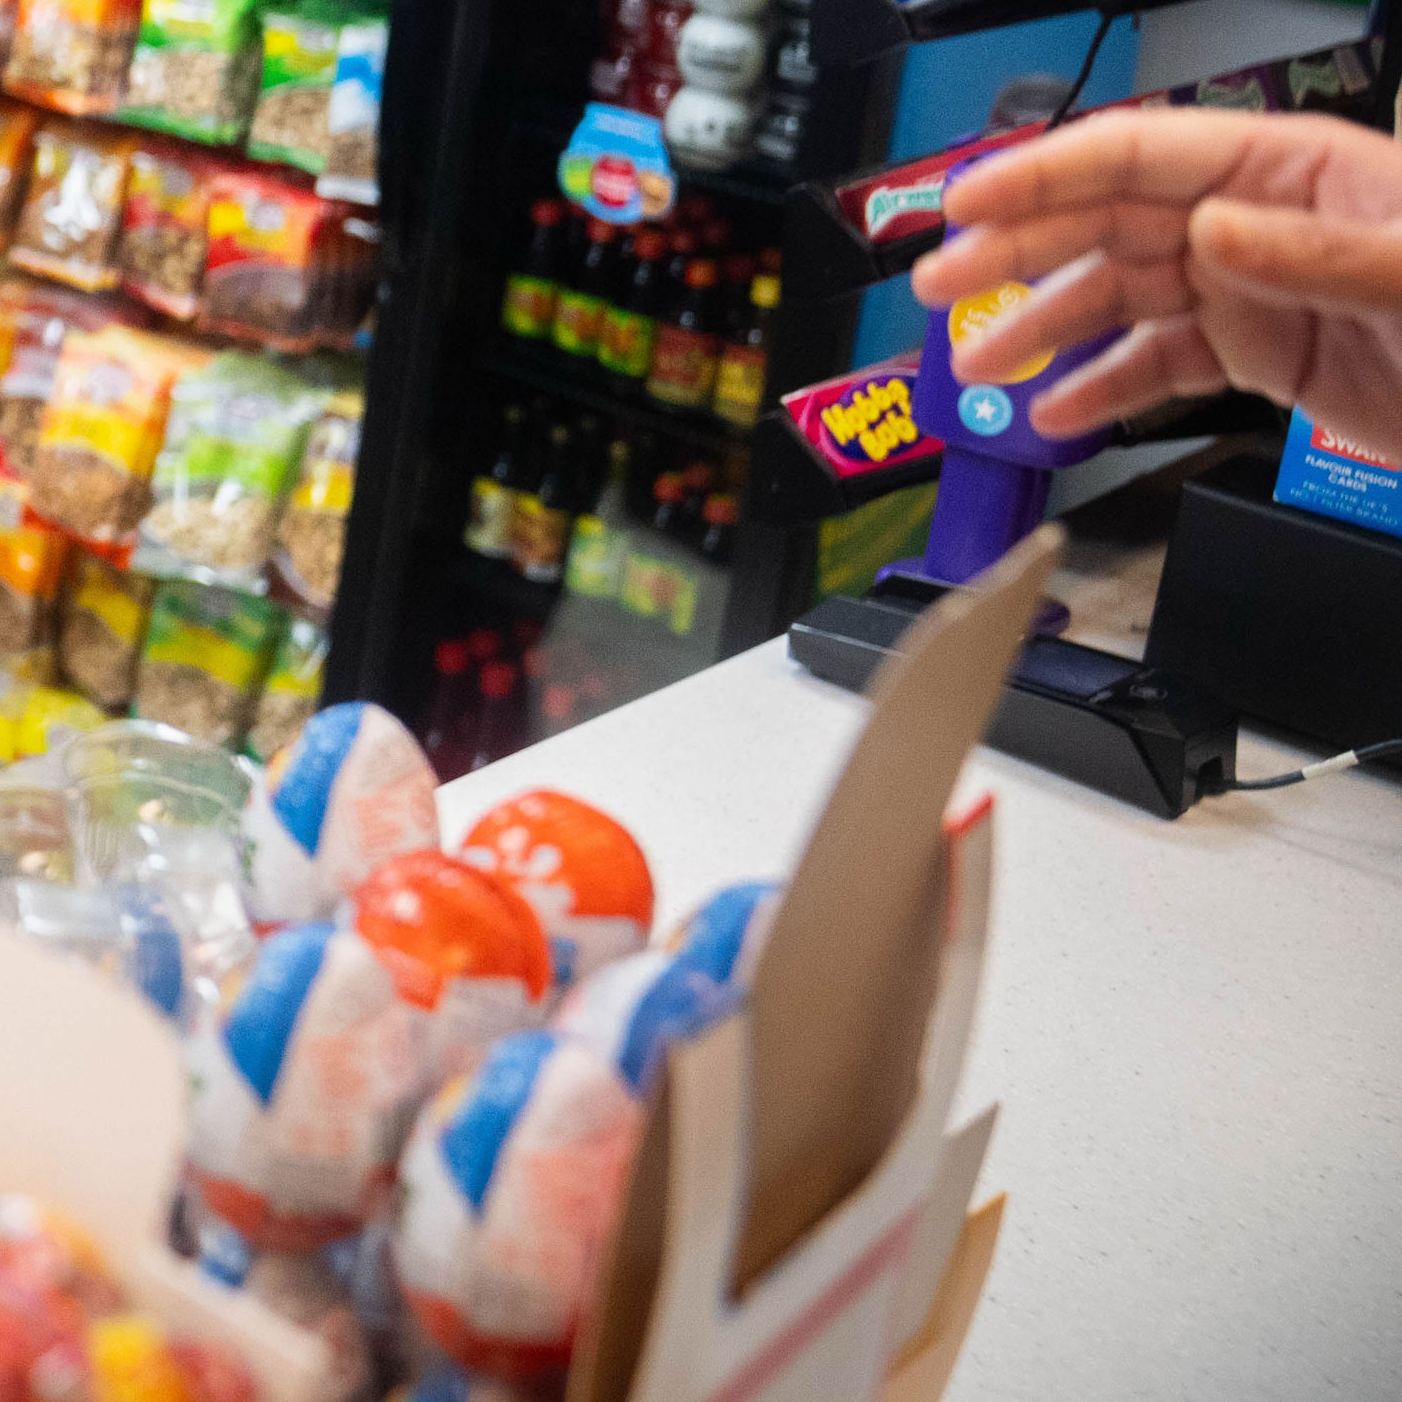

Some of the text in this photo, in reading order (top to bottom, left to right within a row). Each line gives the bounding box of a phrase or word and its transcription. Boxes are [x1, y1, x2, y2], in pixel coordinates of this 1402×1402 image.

[1305, 454, 1398, 489] FLAVOUR FUSION
[1328, 472, 1367, 493] CARDS
